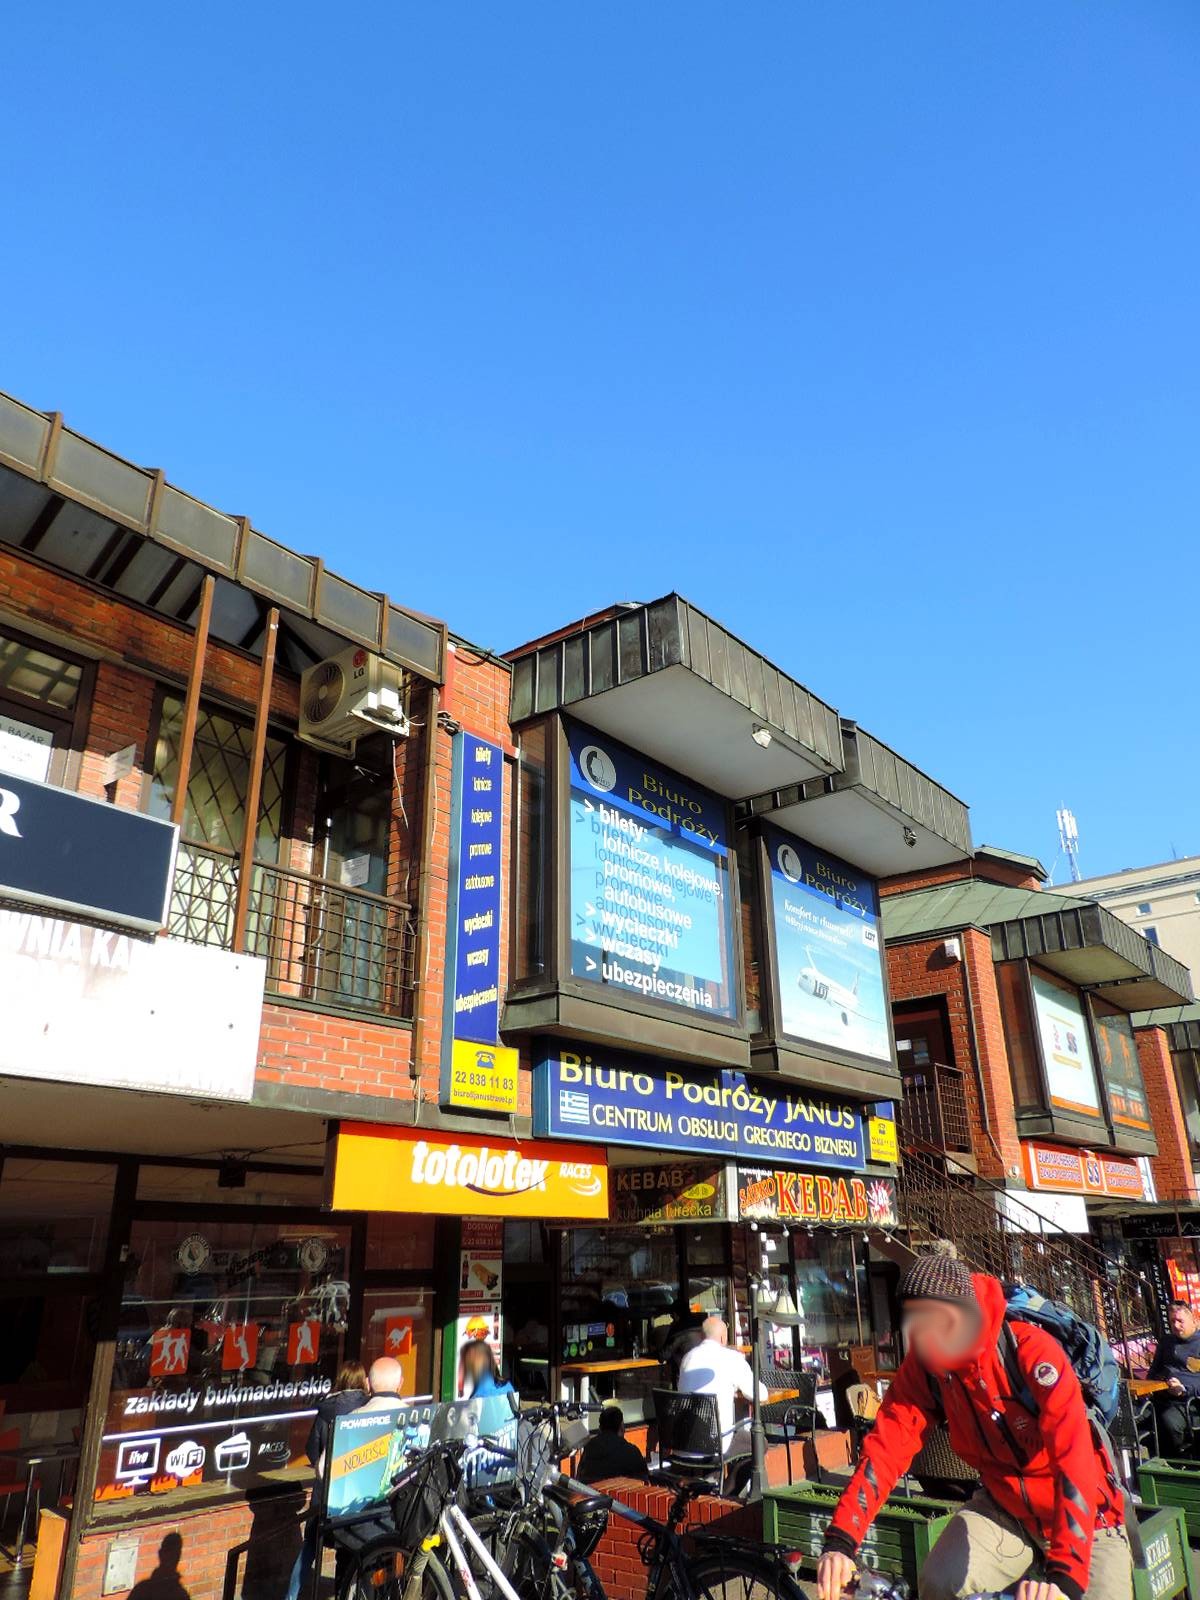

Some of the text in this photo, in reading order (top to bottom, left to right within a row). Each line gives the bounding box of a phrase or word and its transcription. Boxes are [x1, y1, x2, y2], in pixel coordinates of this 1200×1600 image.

[353, 667, 365, 680] LG
[642, 772, 702, 815] Biuro
[628, 787, 720, 847] Podróży
[805, 873, 868, 917] Podróży
[815, 861, 857, 892] Biuro
[603, 883, 692, 929] autobusowe
[601, 913, 679, 949] wycieczki
[865, 931, 875, 942] LOT
[600, 936, 661, 971] wczasy
[602, 962, 713, 1009] ubezpieczenia
[455, 1071, 514, 1091] 22 838 11 83
[559, 1051, 855, 1130] Biuro Podróży JANUS
[592, 1103, 673, 1134] CENTRUM
[678, 1115, 738, 1142] OBSŁUGI
[743, 1124, 811, 1152] GRECKIEGO
[814, 1137, 857, 1158] BIZNESU
[411, 1140, 592, 1192] totolotek RACES
[617, 1170, 684, 1192] KEBAB
[665, 1203, 712, 1218] turecka
[774, 1171, 868, 1221] KEBAB
[124, 1376, 332, 1416] zakłady bukmacherskie
[340, 1415, 391, 1430] POWERADE
[128, 1450, 148, 1465] live
